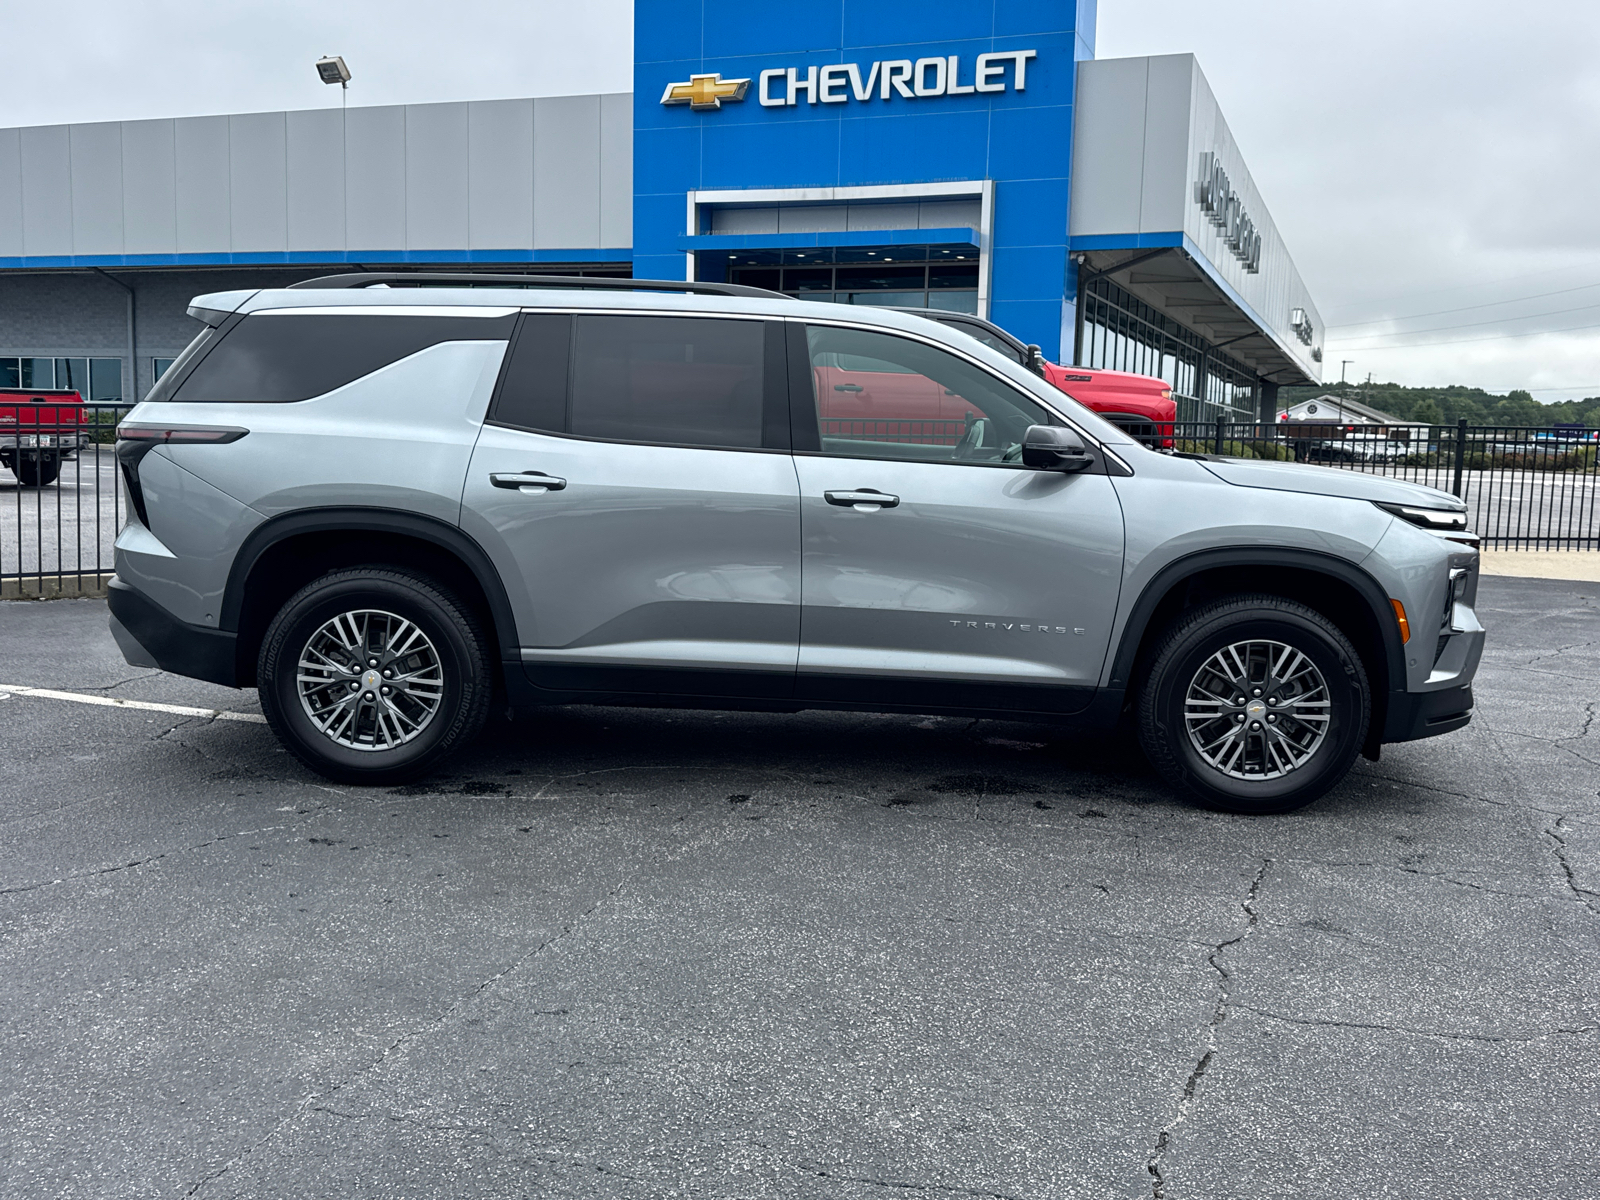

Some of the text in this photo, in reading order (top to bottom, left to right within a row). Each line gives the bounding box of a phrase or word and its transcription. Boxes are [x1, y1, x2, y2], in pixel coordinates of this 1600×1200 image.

[758, 49, 1037, 107] CHEVROLET
[949, 620, 1086, 635] TRAVERSE
[438, 682, 473, 750] BRIDGESTONE
